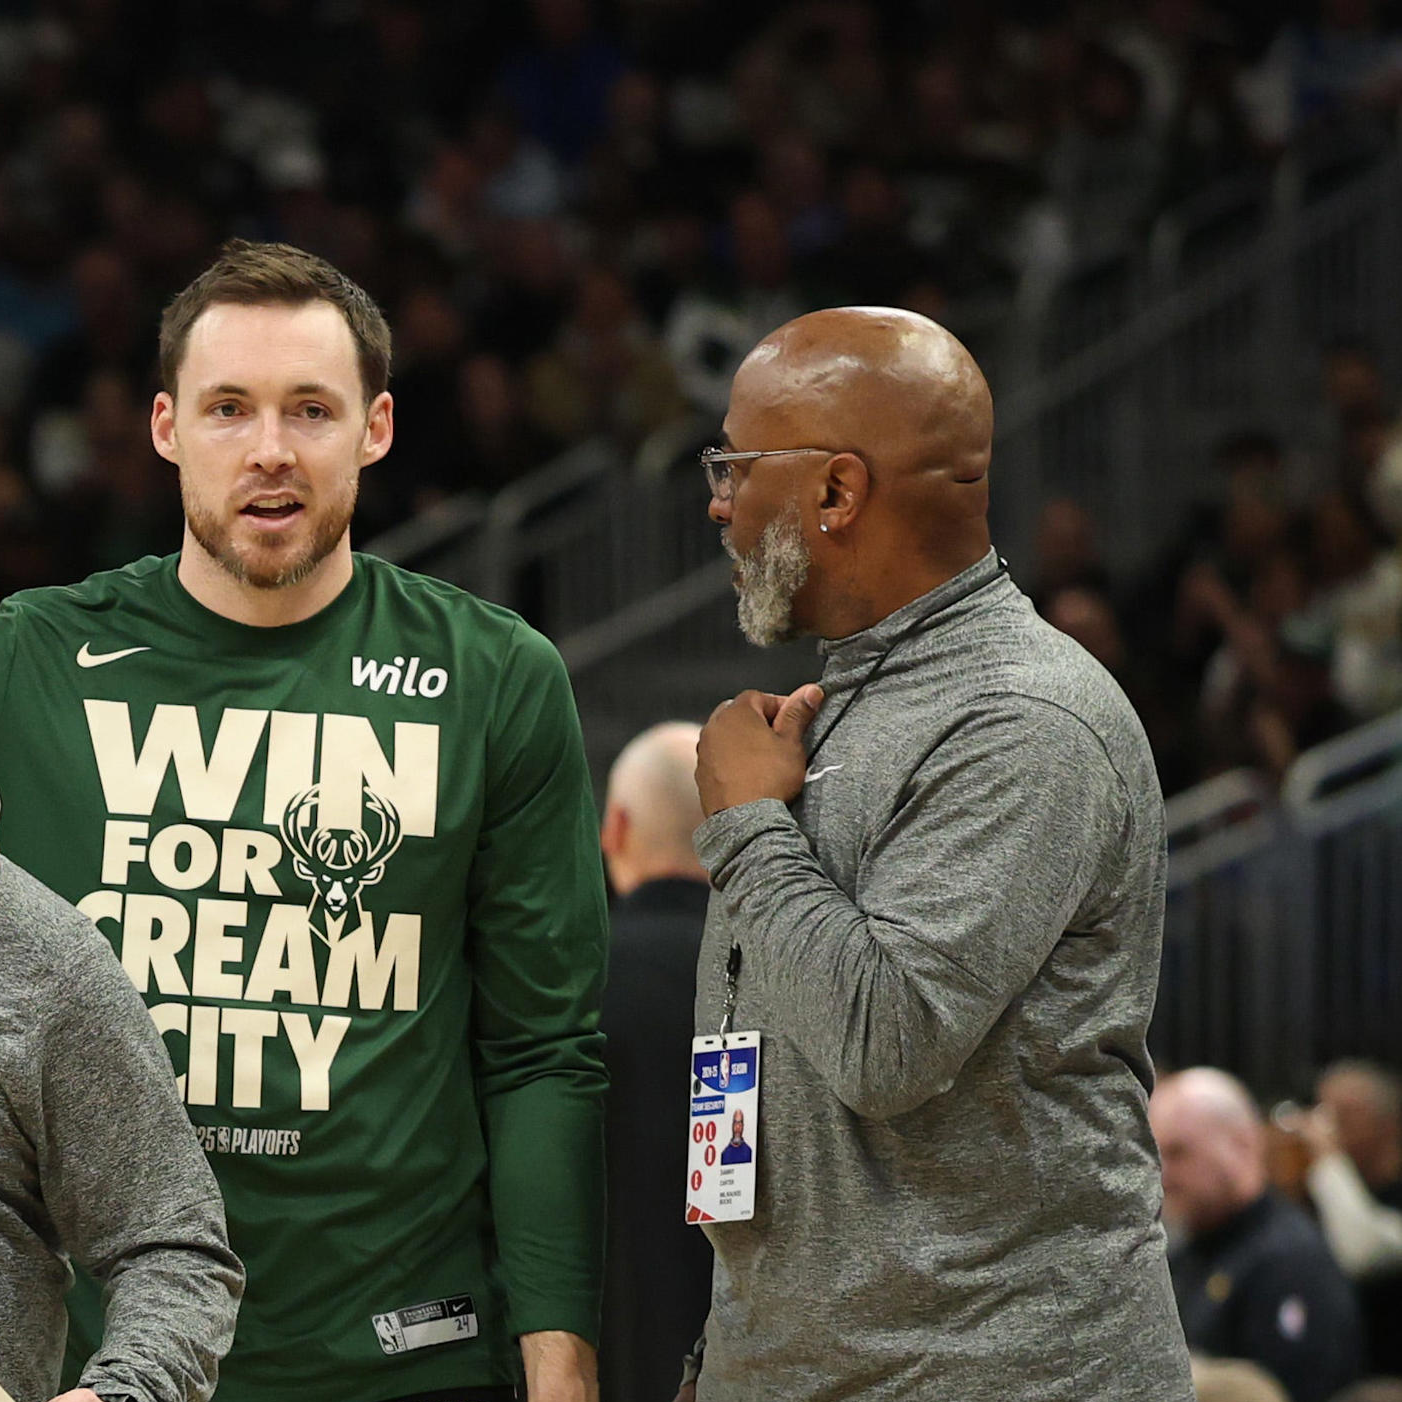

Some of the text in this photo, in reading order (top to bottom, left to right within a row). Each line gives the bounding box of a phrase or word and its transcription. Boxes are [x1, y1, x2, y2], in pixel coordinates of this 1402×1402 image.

[351, 656, 449, 699] wilo
[82, 698, 440, 838] WIN
[100, 819, 283, 896] FOR
[193, 1126, 301, 1155] 25 PLAYOFFS
[455, 1315, 470, 1334] 24
